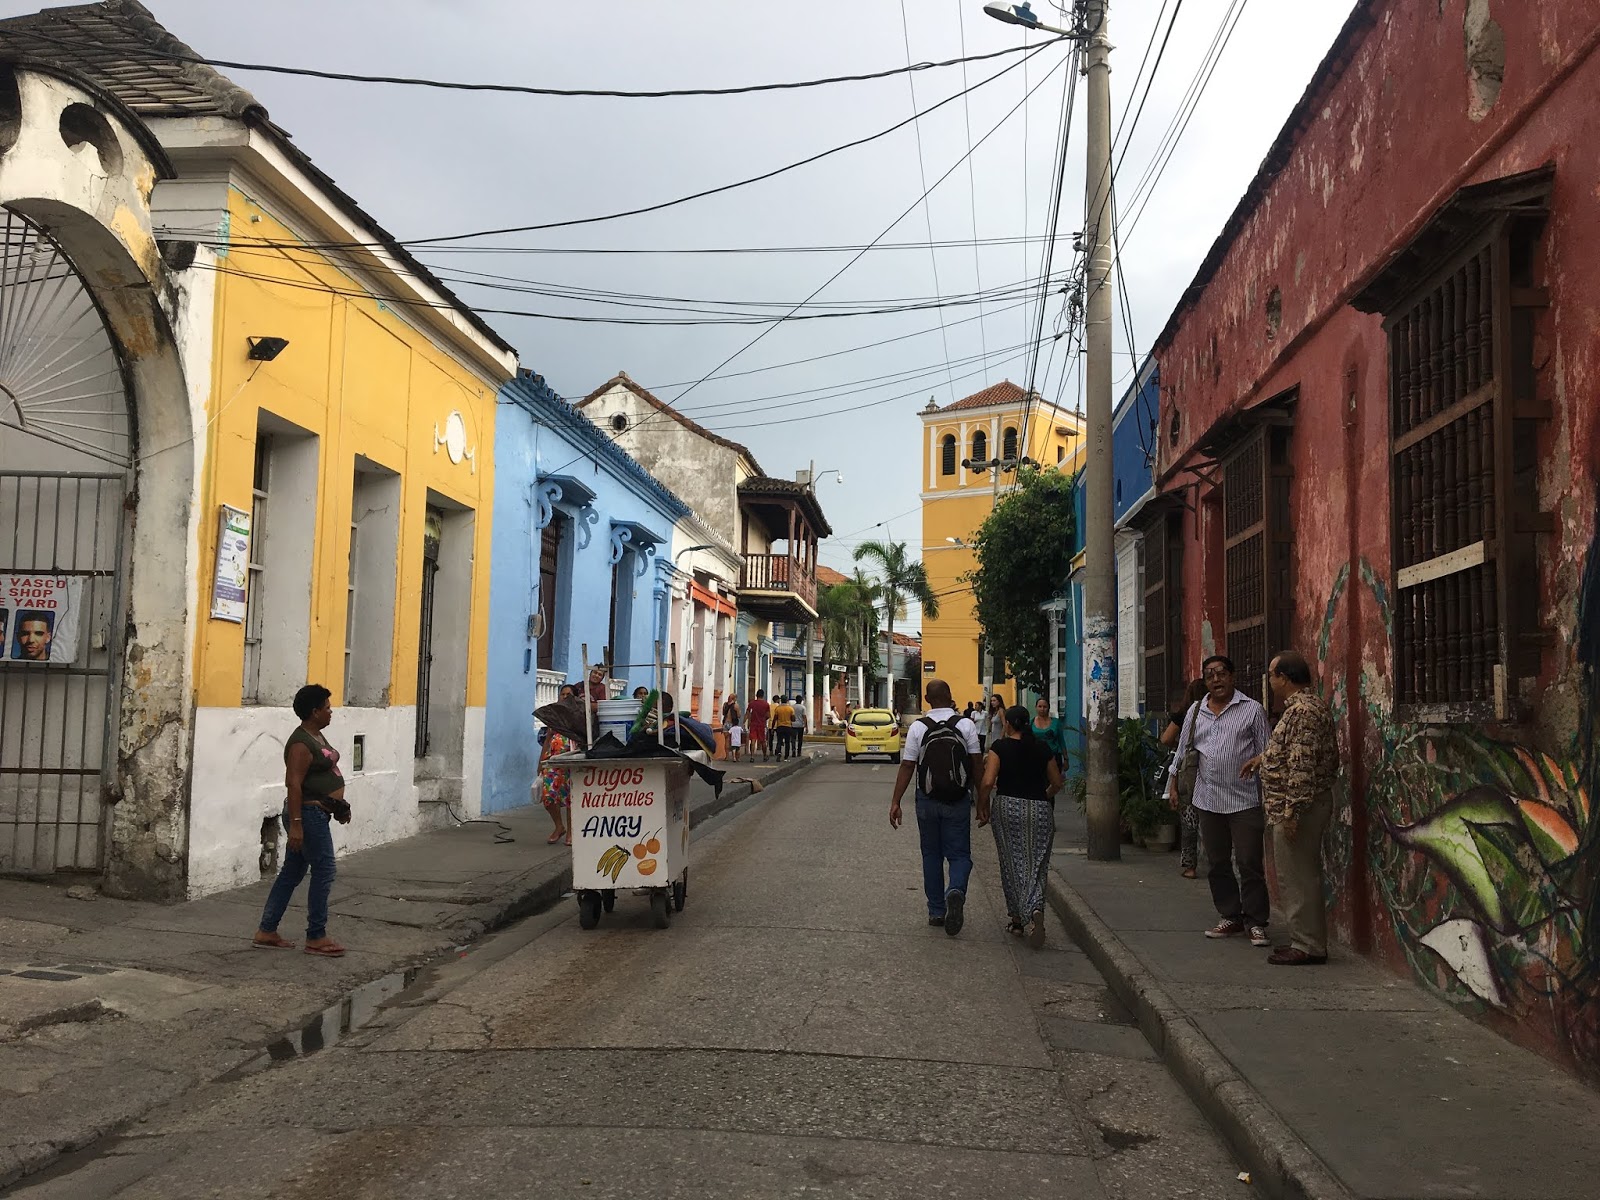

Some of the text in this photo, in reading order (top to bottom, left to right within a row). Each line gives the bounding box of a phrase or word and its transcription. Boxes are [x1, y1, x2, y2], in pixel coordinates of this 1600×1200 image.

[10, 578, 66, 588] VASCO
[9, 588, 53, 598] SHOP
[14, 598, 58, 609] YARD
[583, 766, 644, 791] Jugos
[581, 790, 653, 808] Naturales
[581, 815, 642, 838] ANGY
